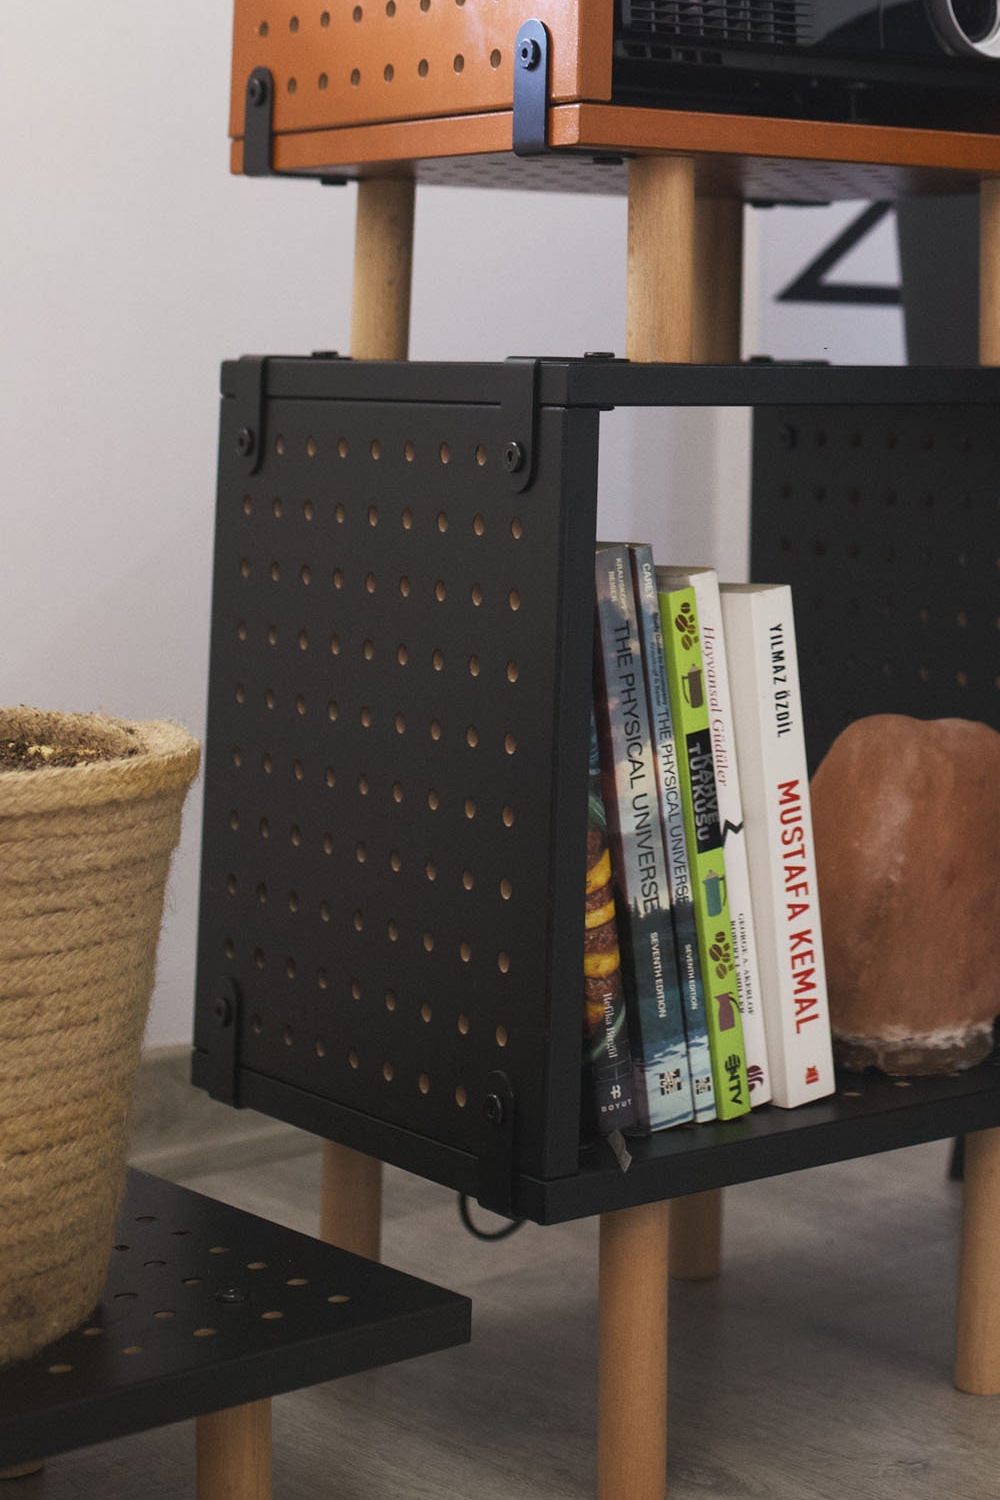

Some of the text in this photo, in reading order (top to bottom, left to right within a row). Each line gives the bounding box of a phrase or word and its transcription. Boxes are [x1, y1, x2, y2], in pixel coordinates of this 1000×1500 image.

[608, 571, 617, 602] BEISER
[642, 562, 655, 599] CAREY
[703, 627, 729, 787] Hayvansal Güdüler
[770, 623, 793, 738] YILMAZ ÖZDİL
[614, 619, 660, 911] THE PHYSICAL UNIVERSE
[688, 742, 711, 841] TUTKUSU
[702, 753, 719, 825] KAHVE
[657, 707, 690, 903] THE PHYSICAL UNIVERSE
[738, 913, 748, 954] GEORGE
[777, 779, 820, 1035] MUSTAFA KEMAL
[603, 992, 613, 1025] Refika
[650, 932, 667, 1018] SEVENTH EDITION
[684, 944, 698, 1010] SEVENTH EDITION
[601, 1098, 632, 1112] BOYUT
[728, 1070, 742, 1105] NTV
